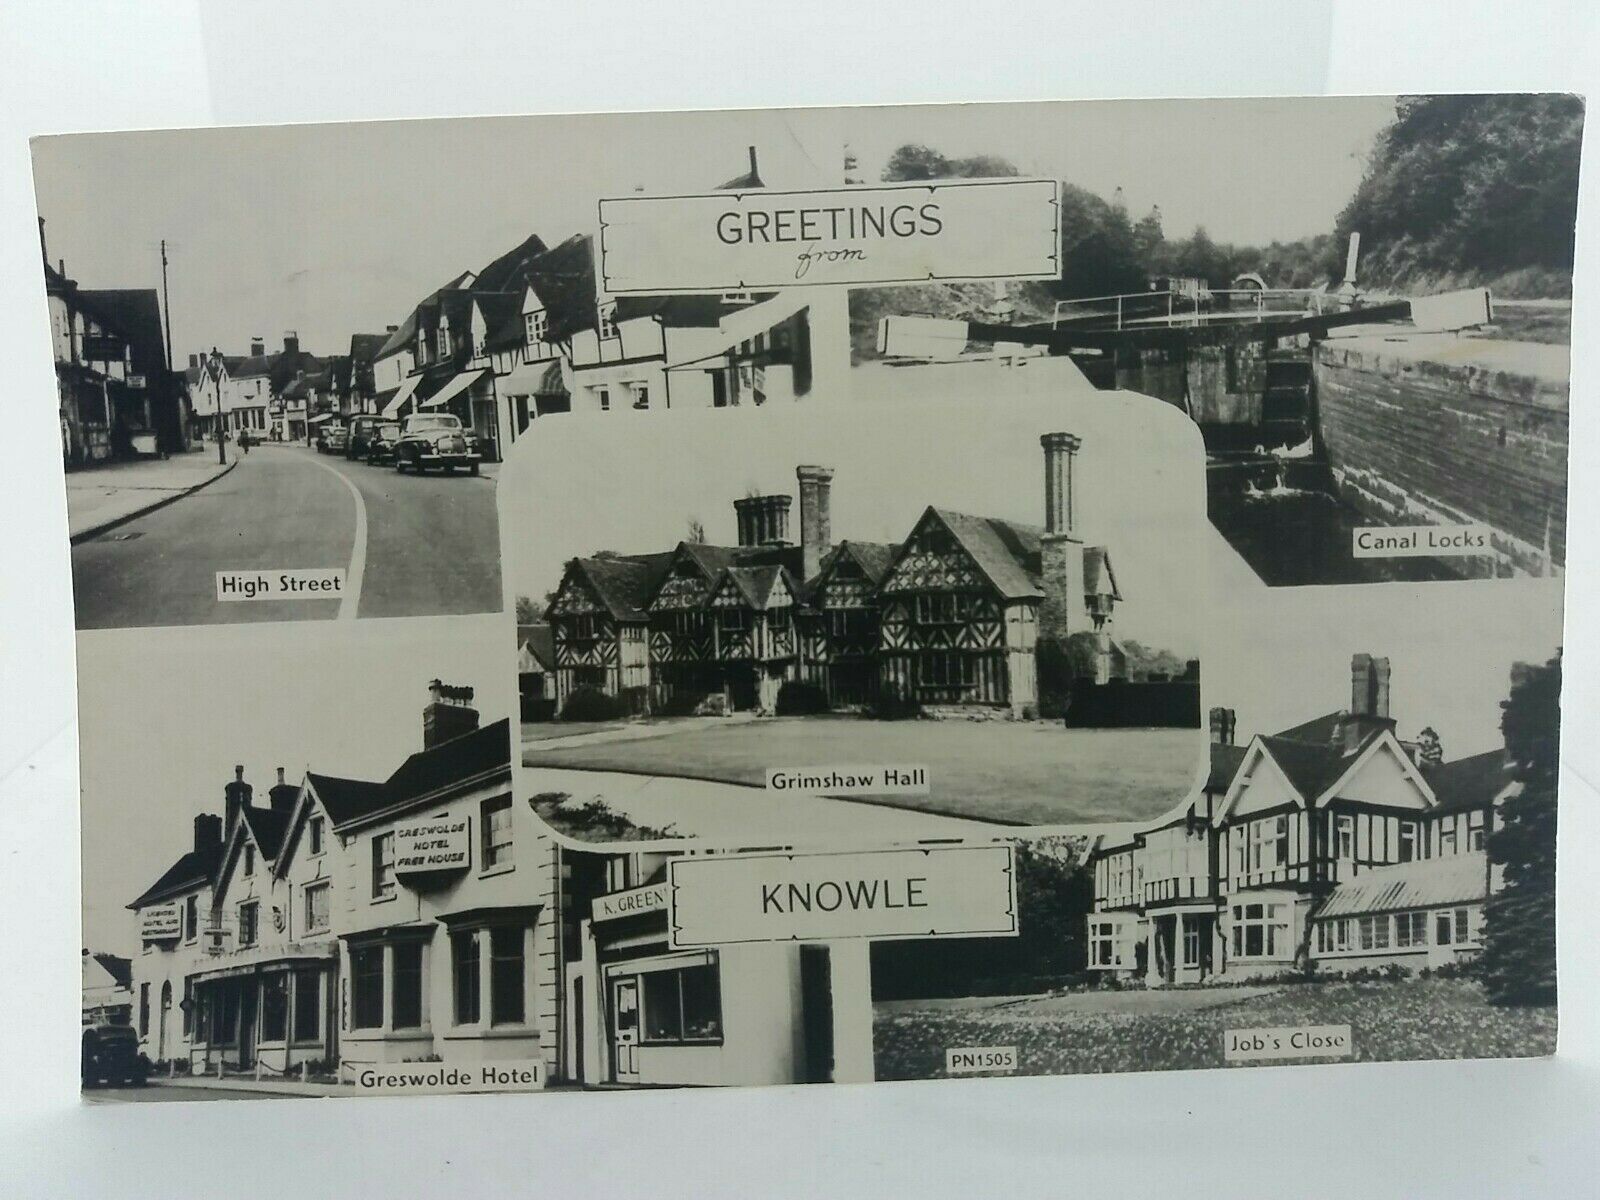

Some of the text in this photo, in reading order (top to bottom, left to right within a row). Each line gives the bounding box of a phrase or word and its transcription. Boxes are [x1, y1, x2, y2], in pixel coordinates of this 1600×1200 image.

[716, 204, 943, 244] GREETINGS
[795, 242, 867, 279] from
[1357, 531, 1485, 550] Canal Locks
[222, 575, 341, 598] High Street
[771, 769, 925, 790] Grimshaw Hall
[398, 823, 466, 838] GRESWOLDE
[413, 840, 450, 851] HOTEL
[397, 852, 465, 866] FREE HOUSE
[762, 878, 928, 914] KNOWLE
[1231, 1032, 1345, 1051] Job's Close
[952, 1053, 1013, 1068] PN1505
[360, 1066, 538, 1088] Greswolde Hotel
